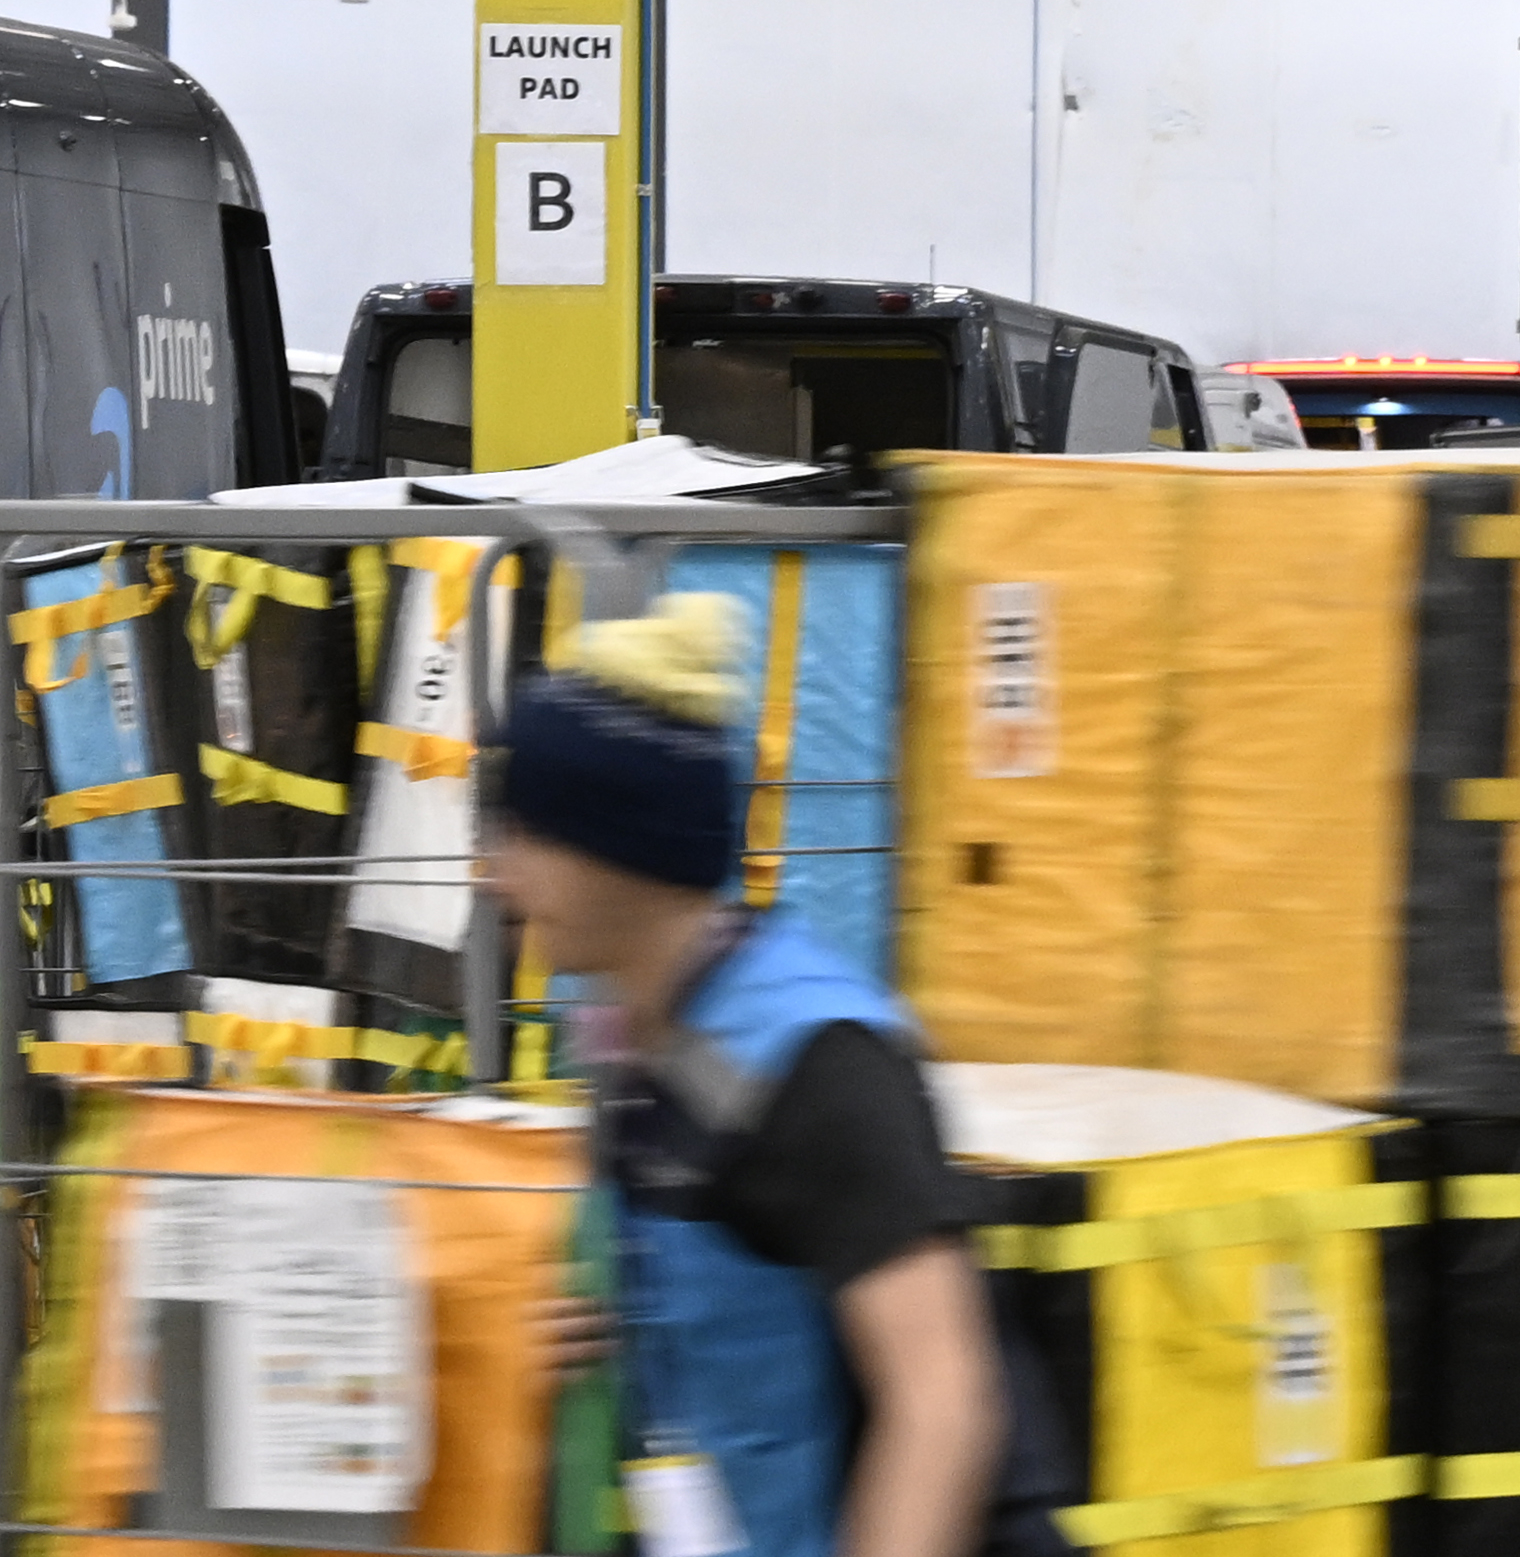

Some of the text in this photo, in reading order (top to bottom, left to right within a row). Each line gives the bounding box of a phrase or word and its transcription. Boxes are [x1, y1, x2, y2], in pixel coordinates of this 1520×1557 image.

[489, 35, 612, 59] LAUNCH
[520, 77, 580, 100] PAD
[529, 171, 575, 232] B
[137, 282, 215, 430] prime
